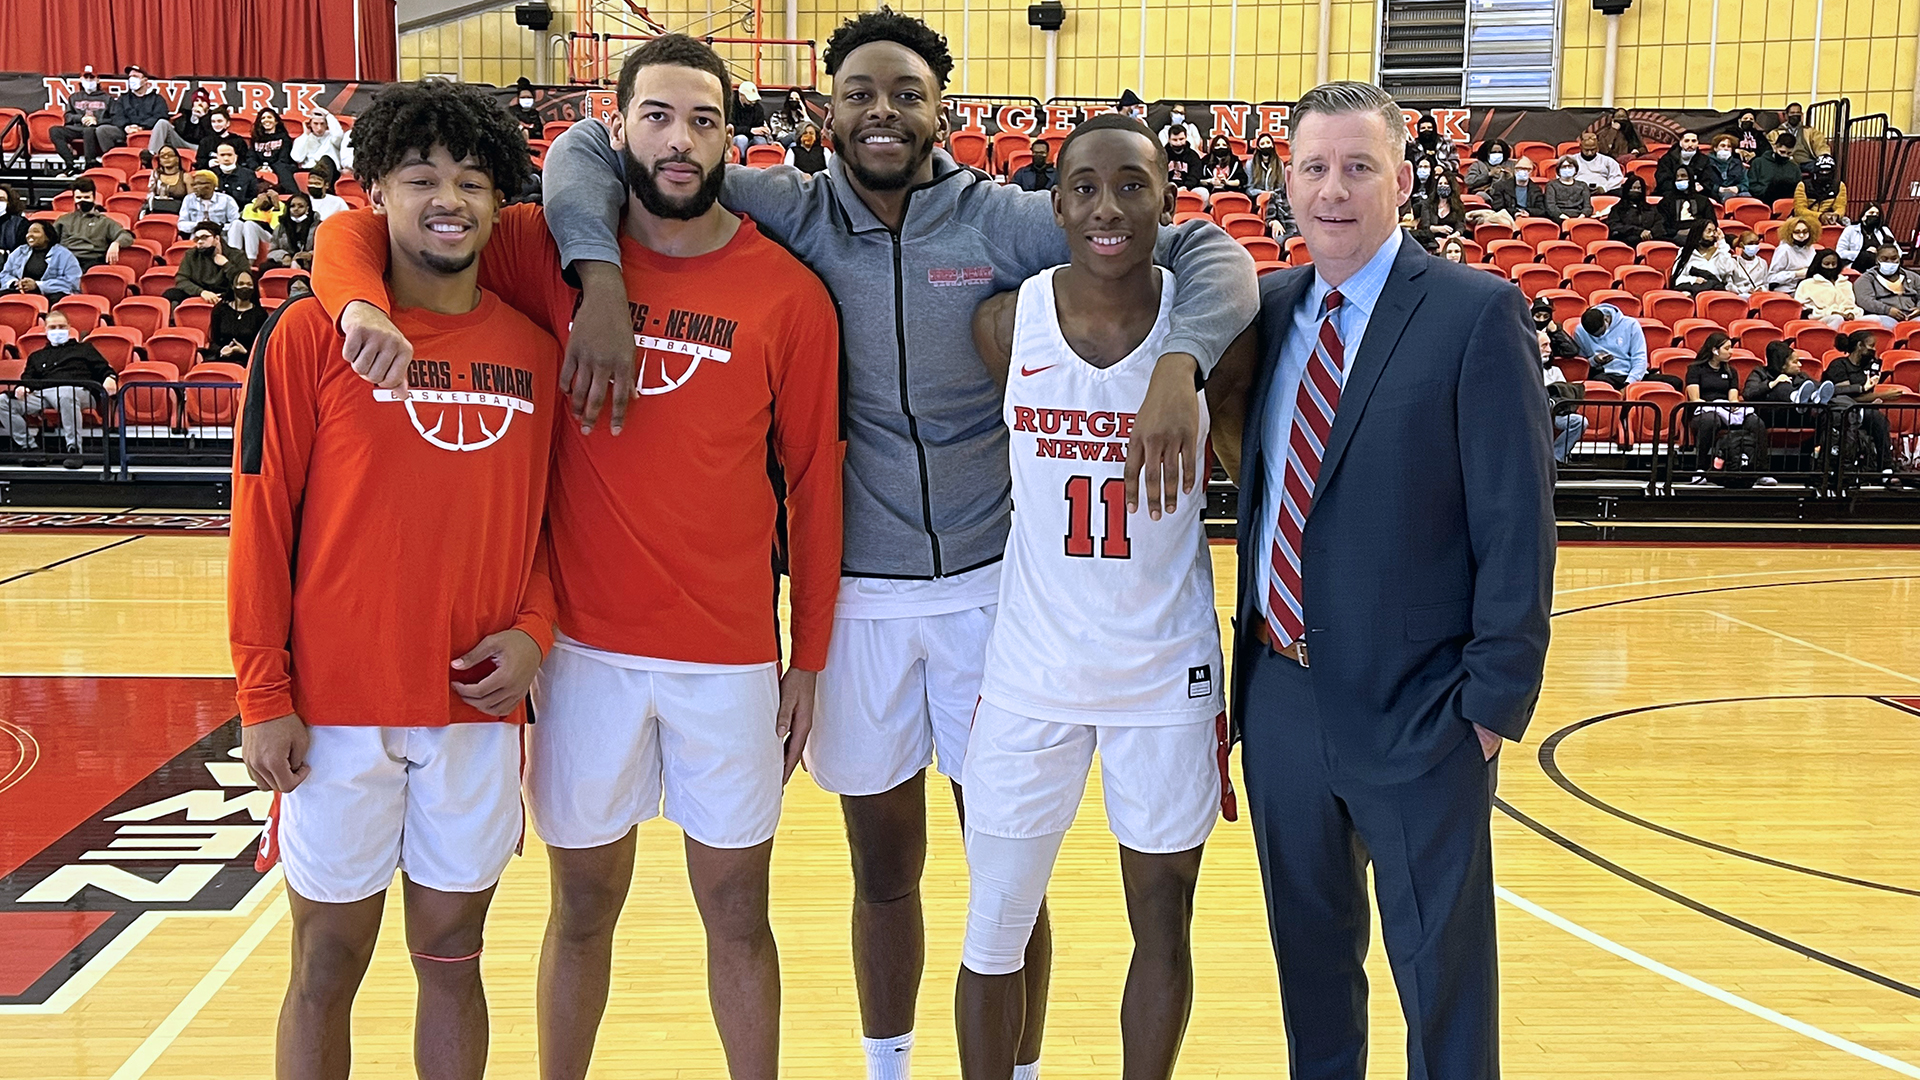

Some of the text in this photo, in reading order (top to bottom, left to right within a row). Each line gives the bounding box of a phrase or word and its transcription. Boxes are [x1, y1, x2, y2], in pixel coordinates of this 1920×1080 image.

[1209, 104, 1472, 143] NERK
[638, 336, 715, 358] ETBALL
[664, 309, 738, 349] NEWARK
[390, 359, 451, 389] GERS
[470, 361, 534, 400] NEWARK
[1013, 405, 1138, 438] RUTGE
[1036, 437, 1129, 462] NEWA
[1064, 475, 1132, 560] 11
[1195, 669, 1205, 680] M
